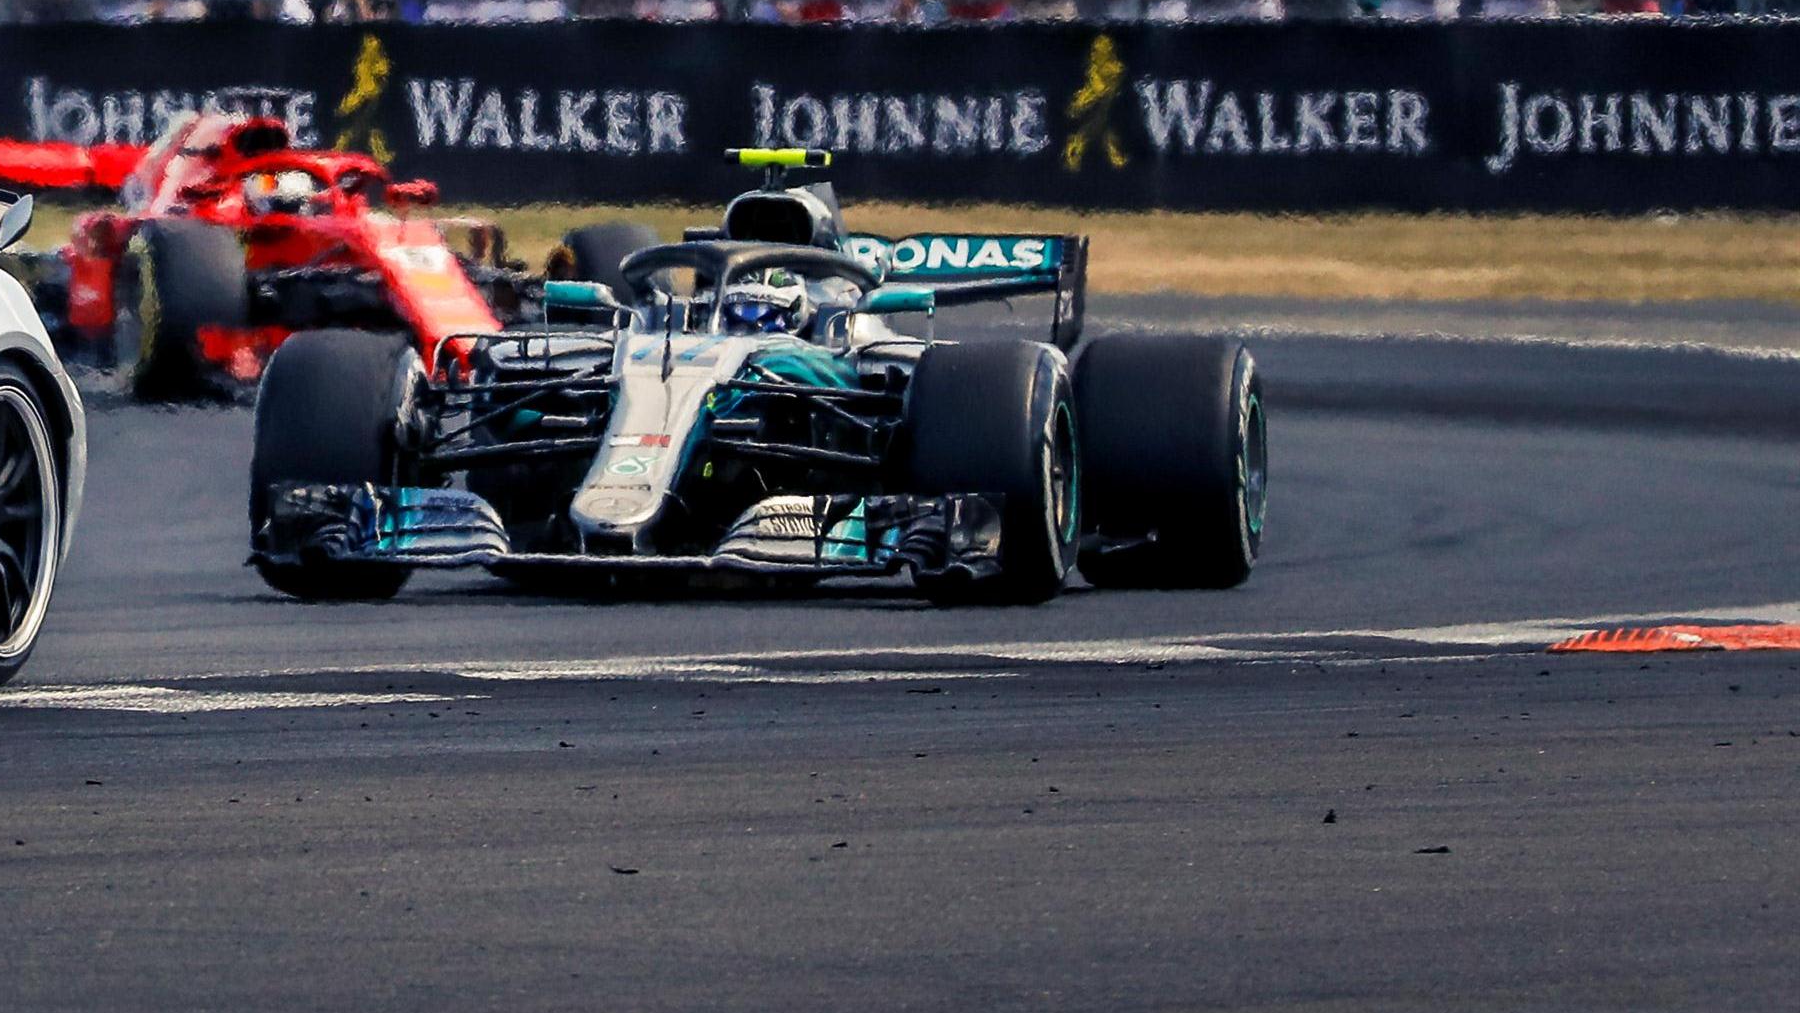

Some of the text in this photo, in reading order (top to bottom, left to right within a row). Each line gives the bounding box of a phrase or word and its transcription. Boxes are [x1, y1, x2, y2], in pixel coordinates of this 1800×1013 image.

[407, 77, 687, 156] WALKER
[752, 78, 1430, 155] JOHNNIE WALKER
[1486, 81, 1800, 172] JOHNNIE
[845, 237, 1045, 270] RONAS
